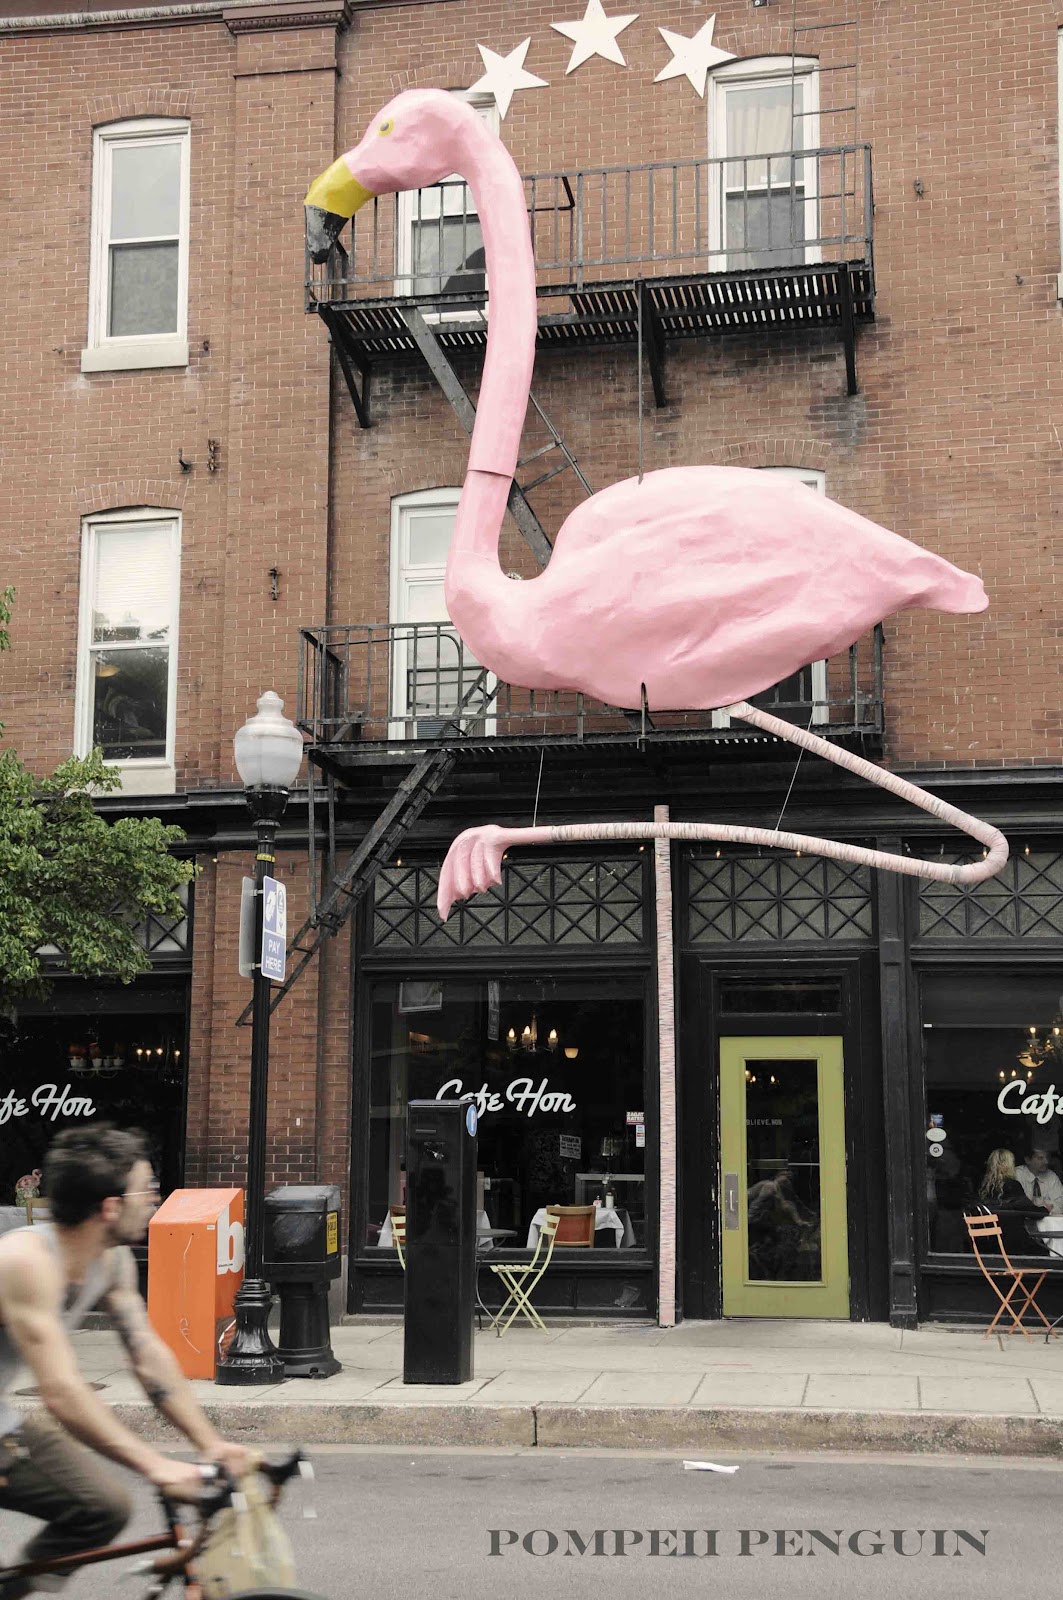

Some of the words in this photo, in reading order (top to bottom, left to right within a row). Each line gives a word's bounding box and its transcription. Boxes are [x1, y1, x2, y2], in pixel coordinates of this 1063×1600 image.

[268, 939, 280, 954] PAY
[266, 957, 281, 972] HERE
[0, 1088, 30, 1126] fe
[31, 1083, 97, 1122] Hon
[506, 1077, 577, 1118] Hon
